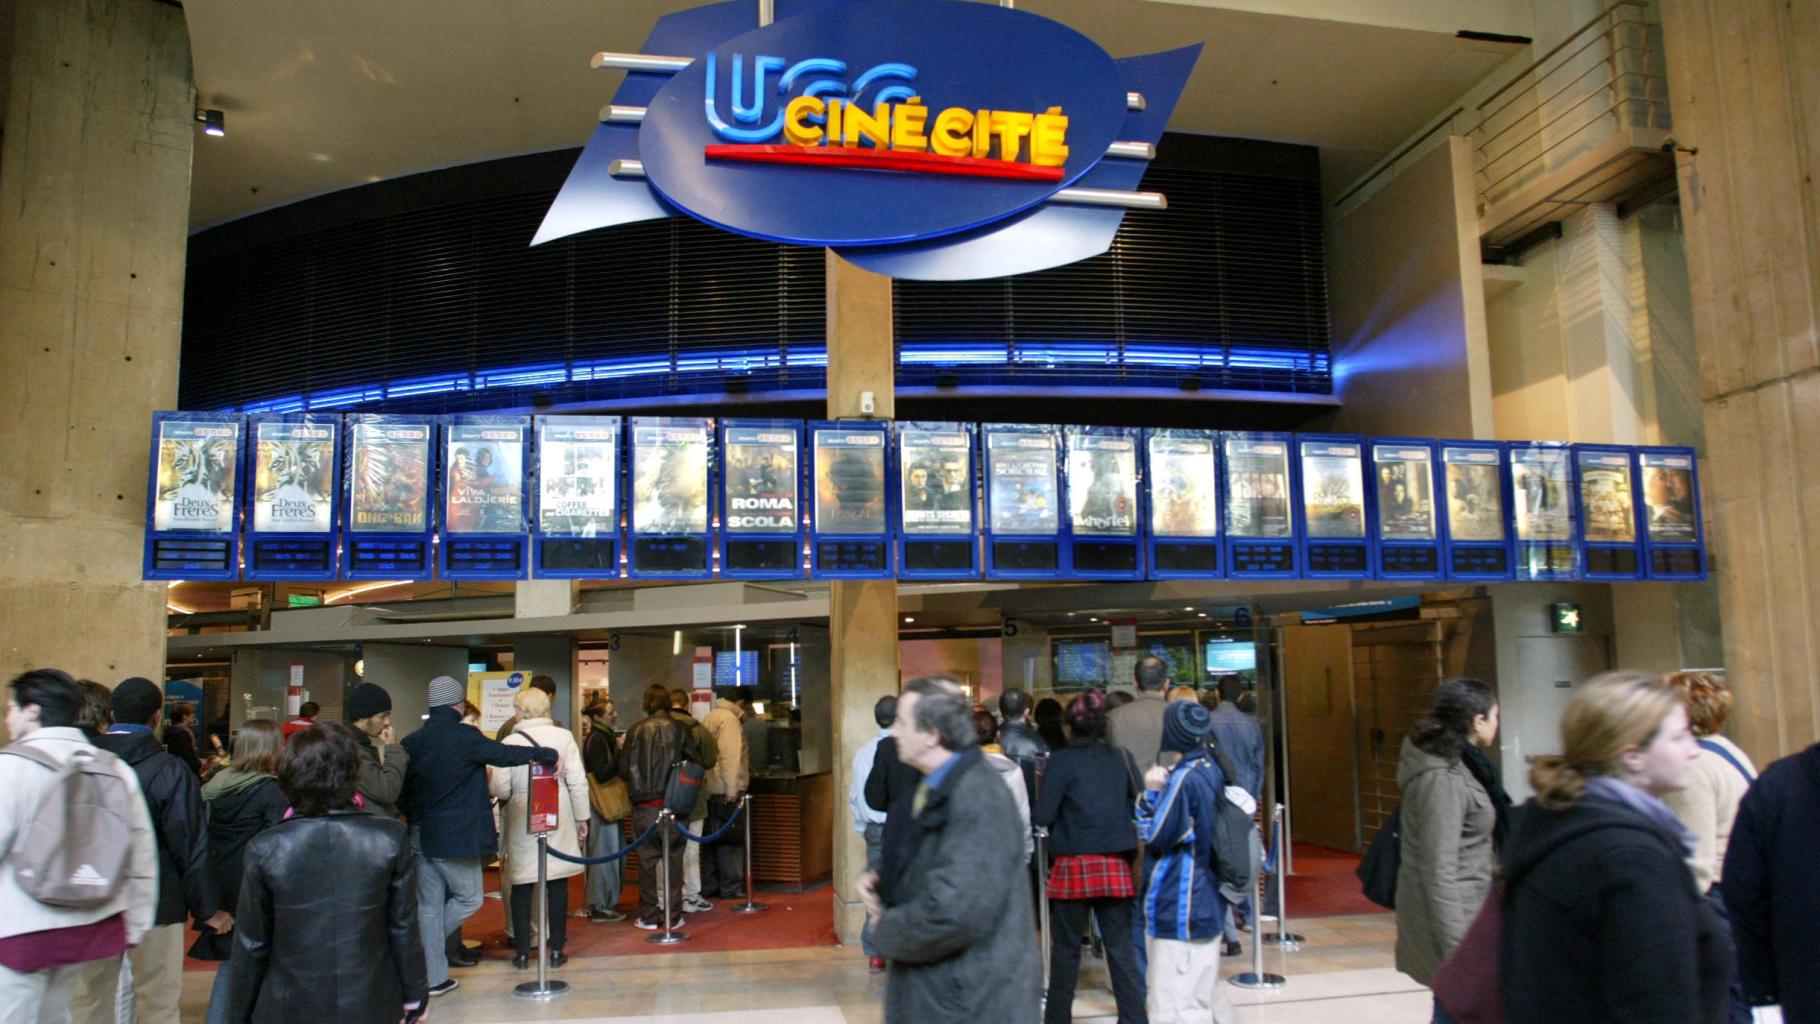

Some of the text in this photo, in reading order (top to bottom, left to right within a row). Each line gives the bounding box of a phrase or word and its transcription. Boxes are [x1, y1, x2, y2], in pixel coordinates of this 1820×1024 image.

[705, 51, 918, 148] UGC
[783, 95, 1069, 167] CINÉ CITÉ
[556, 508, 610, 517] CIGARETT
[732, 498, 793, 509] ROMA
[728, 516, 794, 527] SCOLA
[1003, 617, 1018, 637] 5
[1234, 607, 1250, 628] 6
[610, 633, 621, 652] 3
